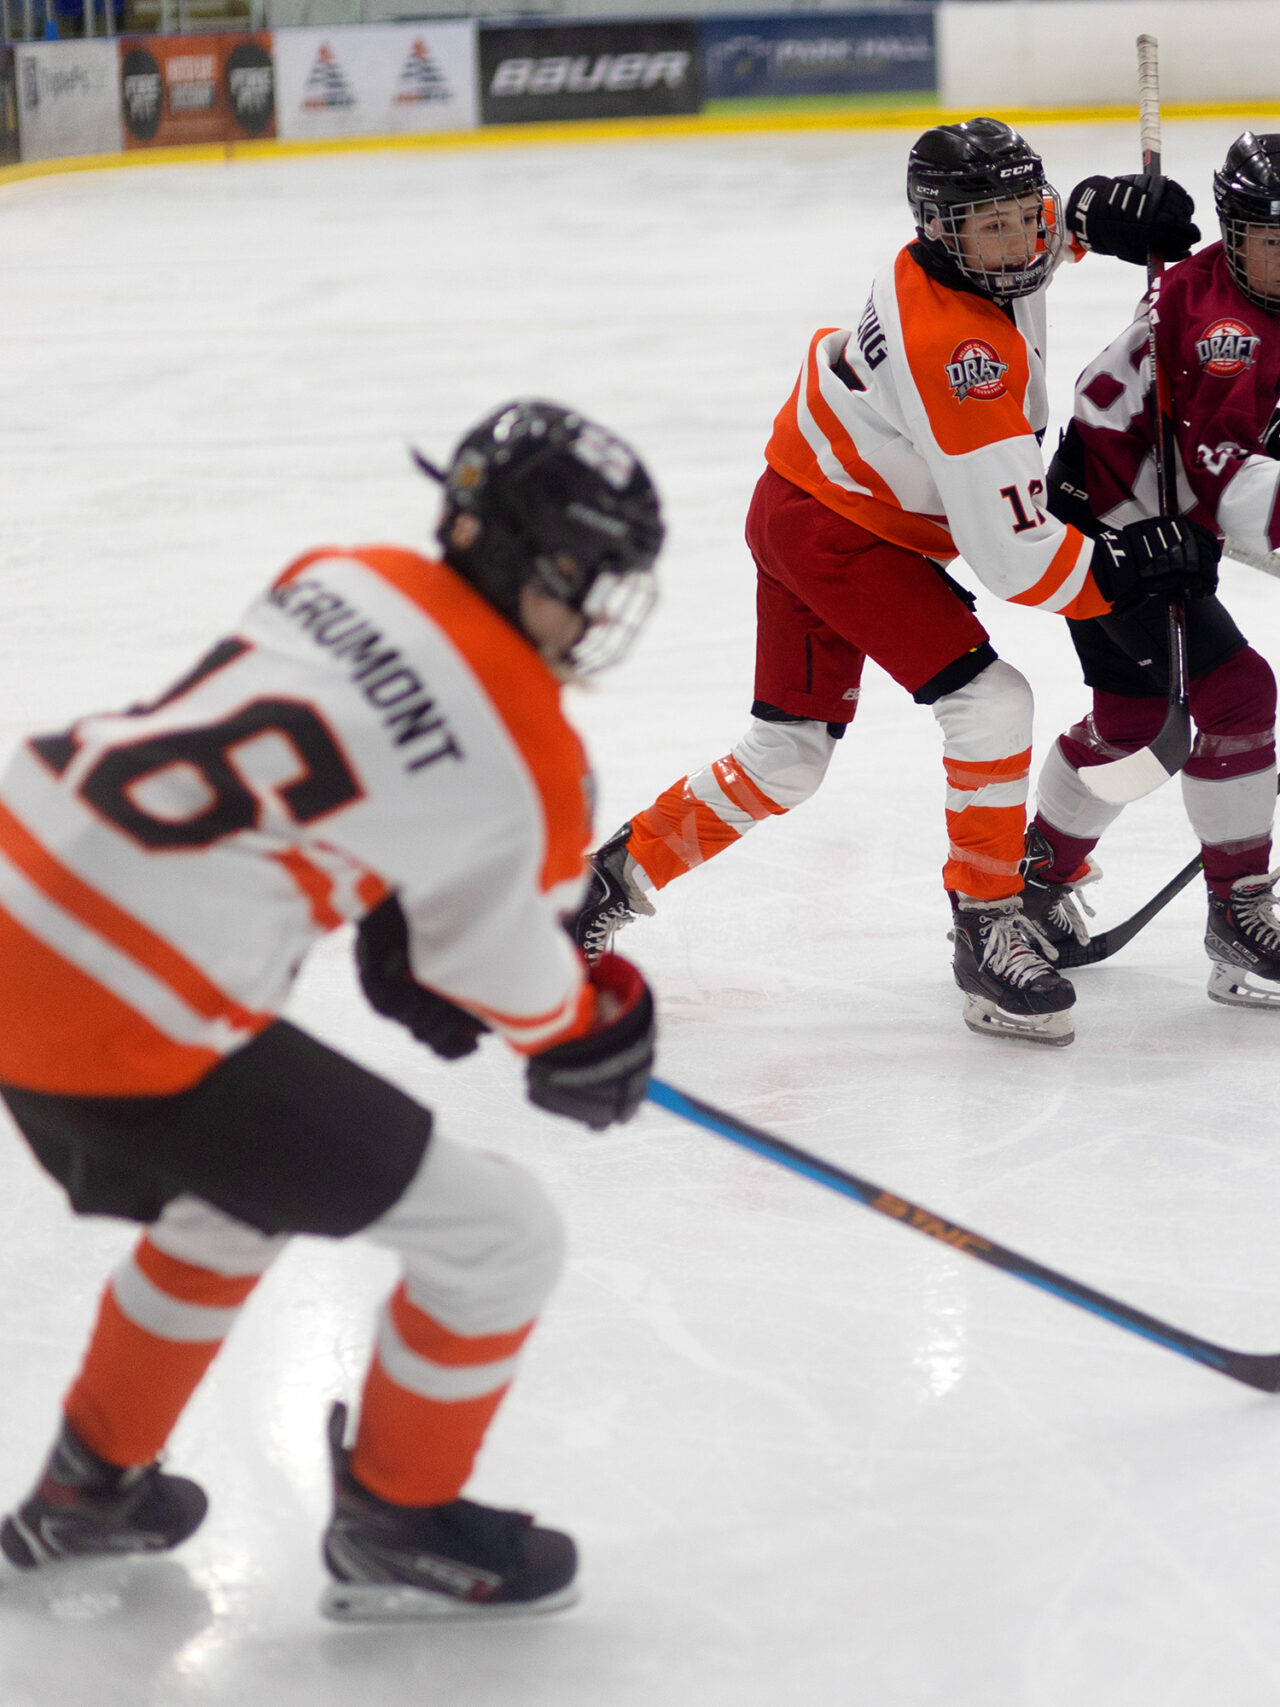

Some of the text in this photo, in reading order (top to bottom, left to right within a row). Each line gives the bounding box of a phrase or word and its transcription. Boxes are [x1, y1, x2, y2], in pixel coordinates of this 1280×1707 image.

[489, 51, 693, 96] BAUER
[1000, 163, 1034, 178] CCM
[916, 185, 939, 196] CCM
[1196, 335, 1260, 361] DRAFT
